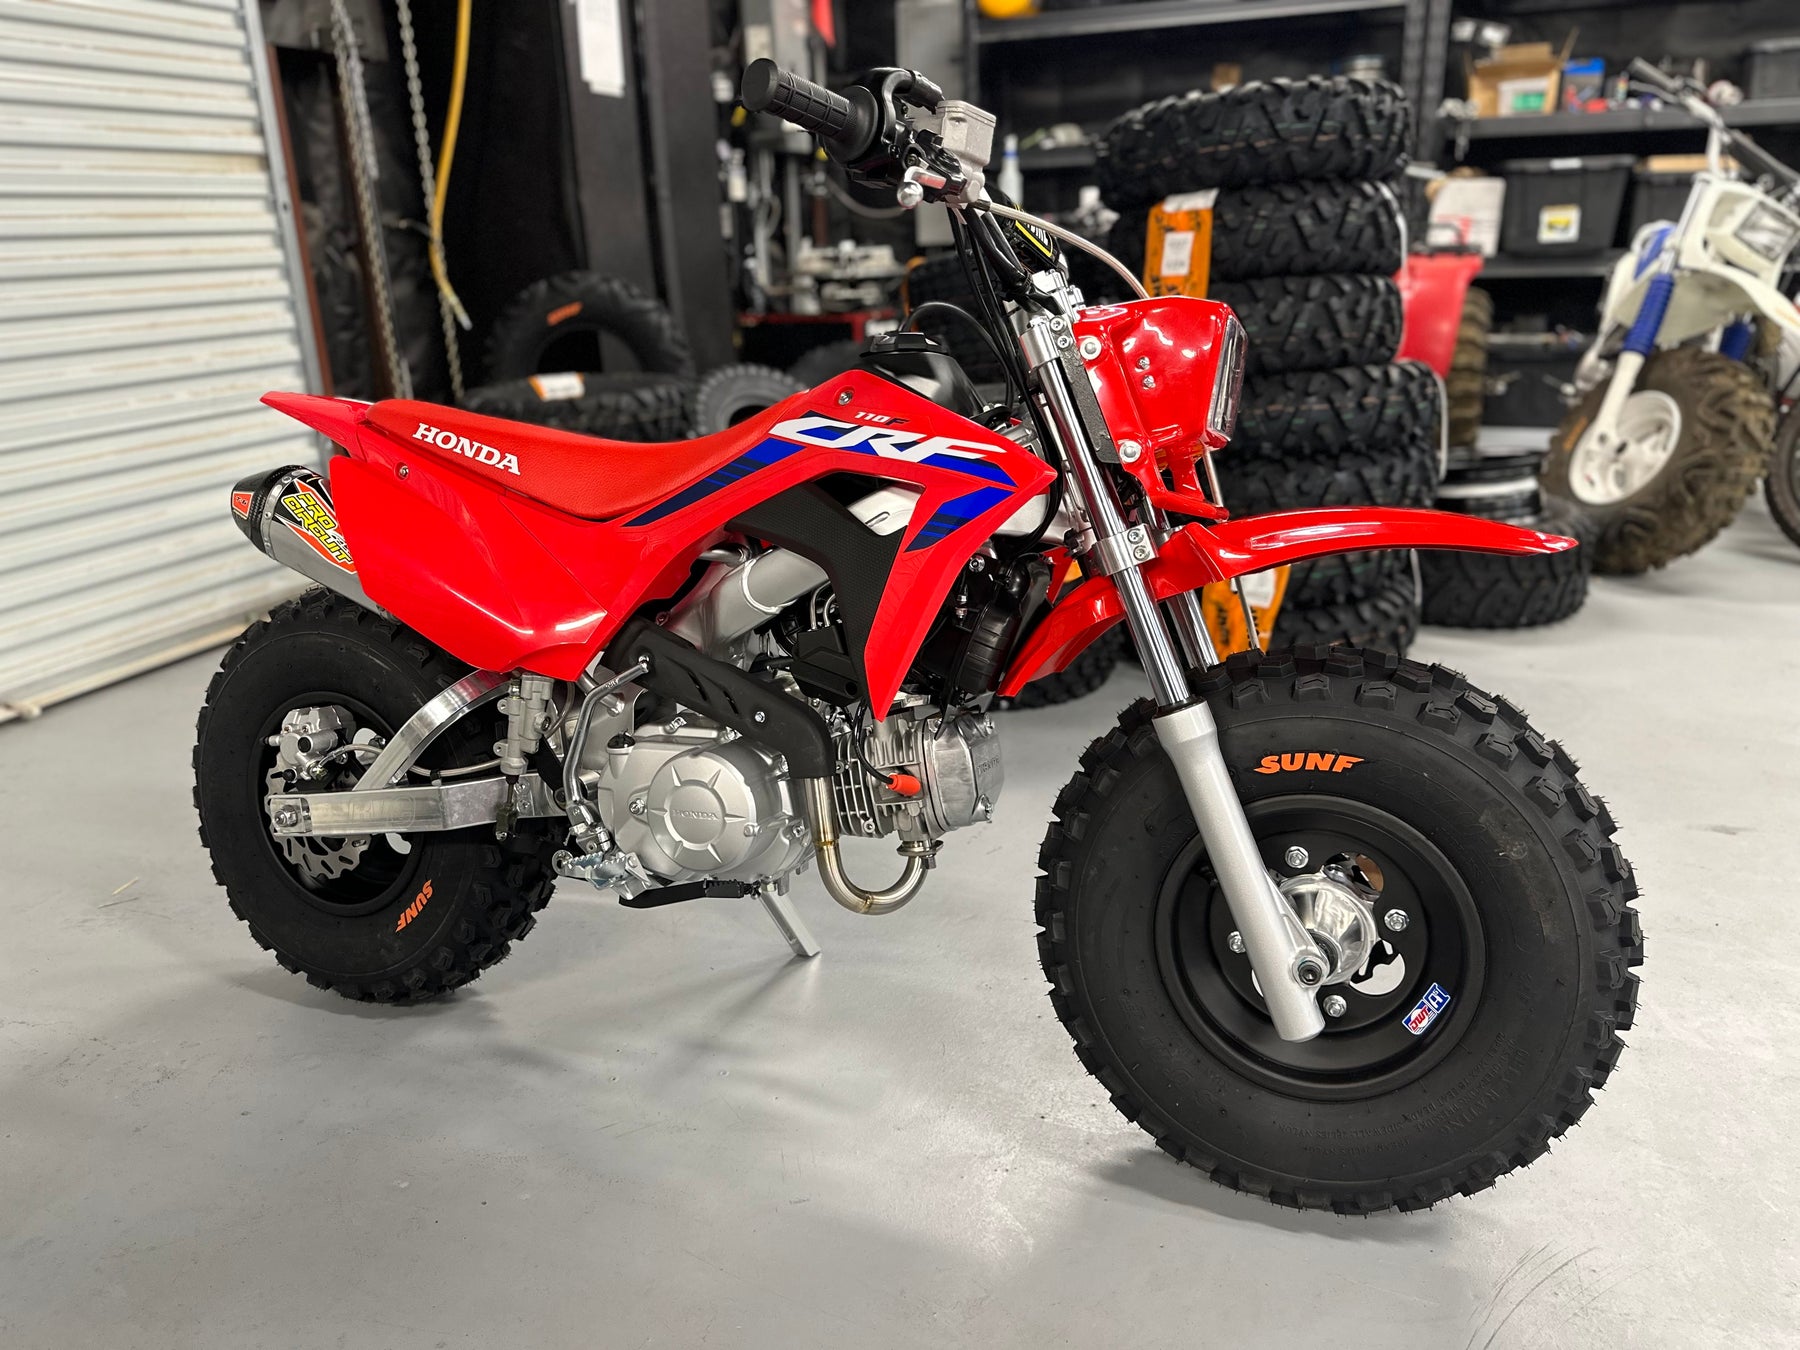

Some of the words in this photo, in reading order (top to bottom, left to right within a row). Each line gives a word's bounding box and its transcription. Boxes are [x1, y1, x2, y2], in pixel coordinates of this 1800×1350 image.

[768, 416, 1007, 463] CRF
[854, 411, 911, 427] 110F
[412, 422, 521, 476] HONDA
[282, 495, 354, 563] CIRCUIT
[297, 493, 337, 530] PRO
[1254, 752, 1364, 774] SUNF
[395, 879, 434, 933] SUNF
[1408, 1004, 1430, 1031] DWT
